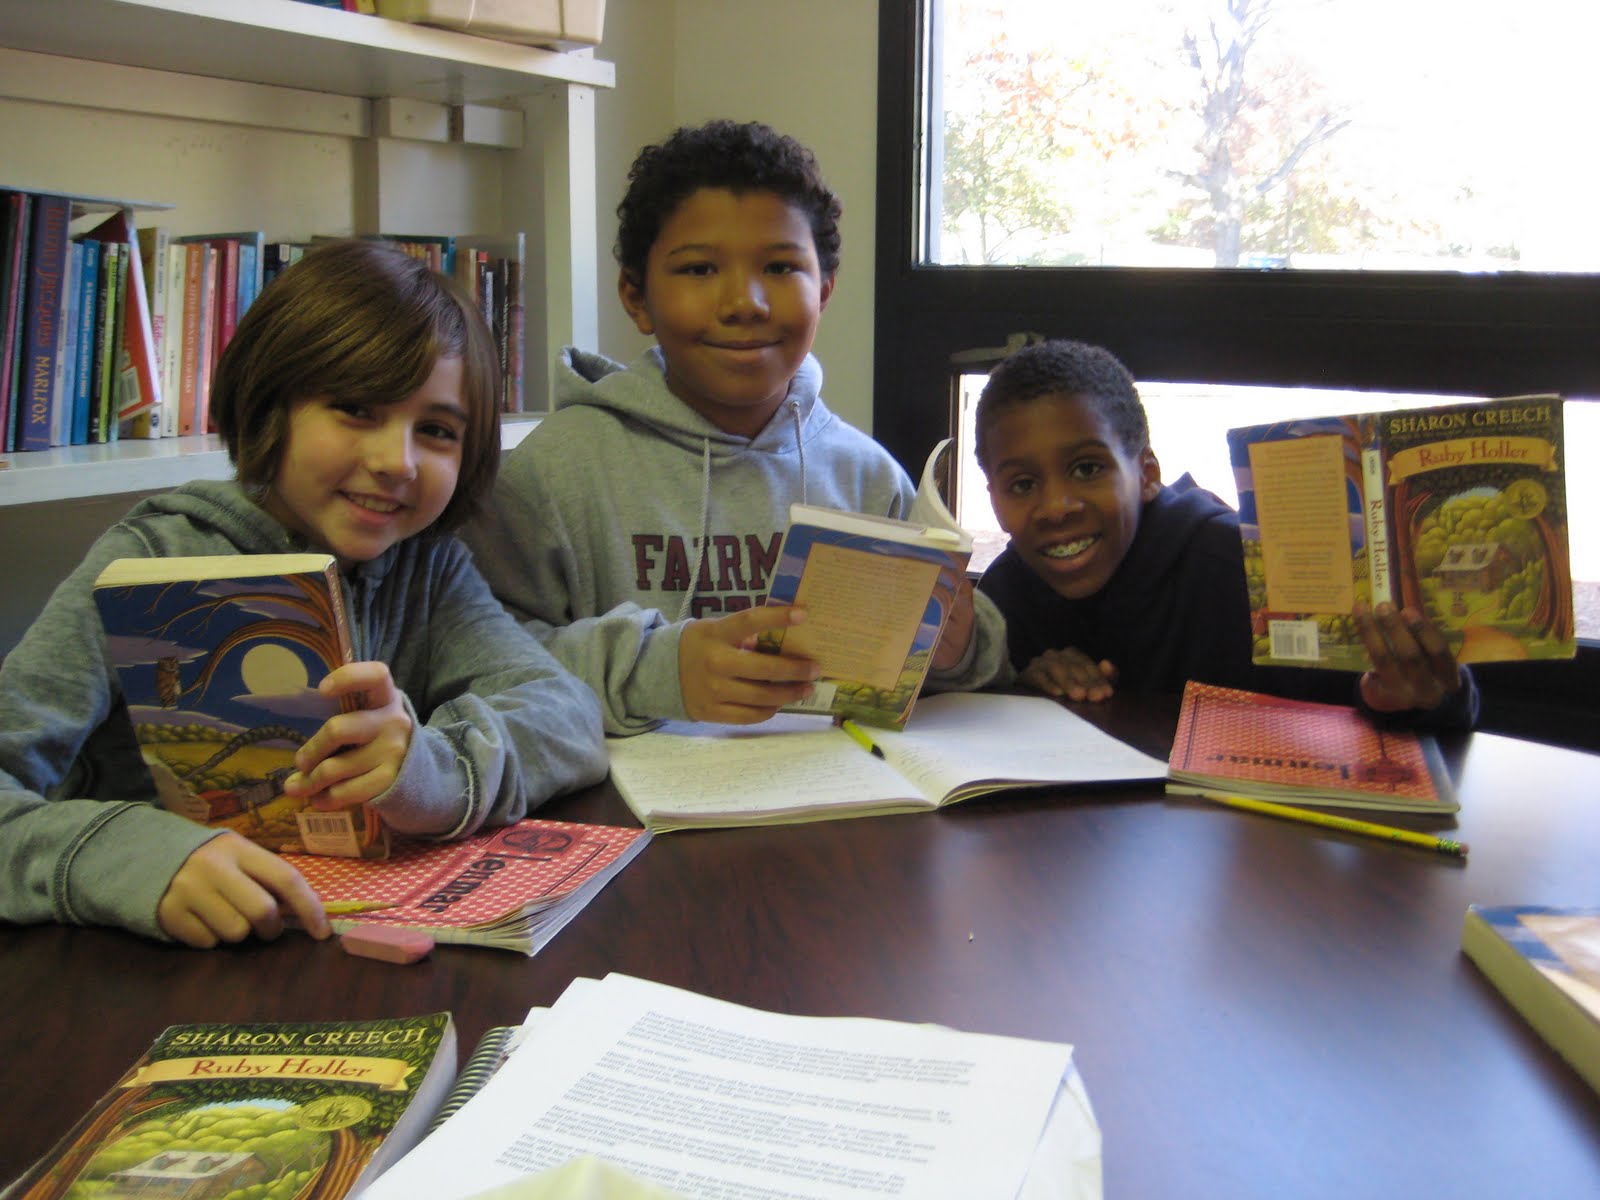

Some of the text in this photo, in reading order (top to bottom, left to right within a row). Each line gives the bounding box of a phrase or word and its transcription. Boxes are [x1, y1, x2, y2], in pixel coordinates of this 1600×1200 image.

[32, 355, 50, 424] MARLFOX
[1390, 412, 1467, 435] SHARON
[1472, 405, 1551, 427] CREECH
[1417, 440, 1529, 467] Ruby Holler
[1369, 499, 1388, 590] Ruby Holler
[170, 1026, 428, 1046] SHARON CREECH
[188, 1057, 372, 1078] Ruby Holler
